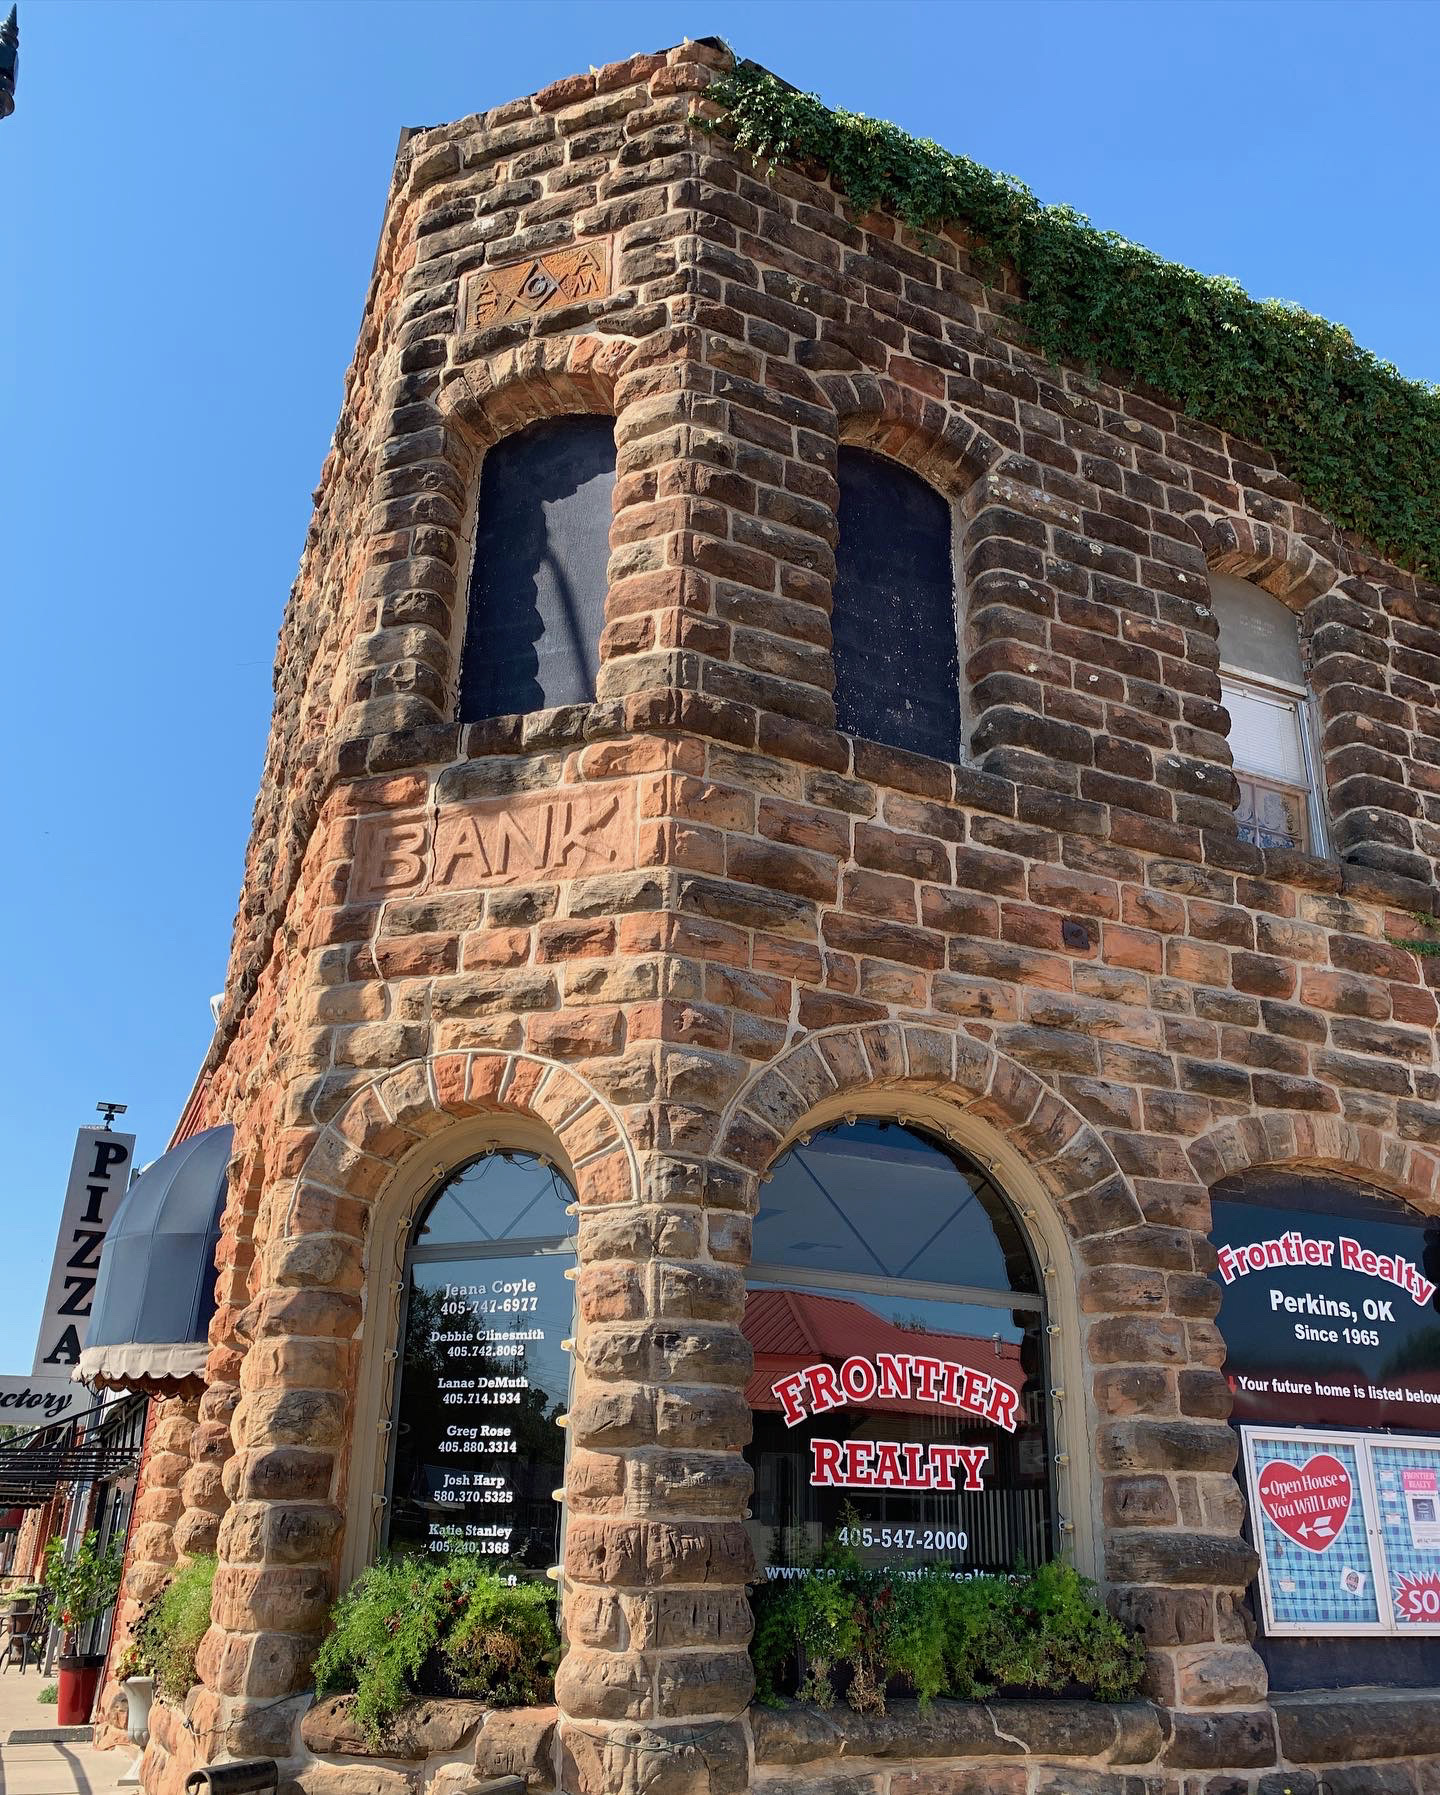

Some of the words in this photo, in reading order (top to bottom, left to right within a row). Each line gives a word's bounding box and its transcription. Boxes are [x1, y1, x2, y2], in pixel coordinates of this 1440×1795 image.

[373, 795, 619, 889] BANK
[43, 1141, 129, 1365] PIZZA
[1217, 1230, 1335, 1285] Frontier
[1338, 1235, 1437, 1307] Realty
[444, 1282, 487, 1300] Jeana
[491, 1279, 536, 1294] Coyle
[440, 1297, 539, 1316] 405-747-6977
[1269, 1289, 1358, 1324] Perkins,
[1362, 1298, 1396, 1322] OK
[430, 1329, 473, 1343] Debbie
[476, 1328, 545, 1341] Clinesmith
[1294, 1323, 1339, 1343] Since
[1342, 1328, 1380, 1346] 1965
[447, 1344, 525, 1358] 405.742.8062
[437, 1377, 475, 1389] Lanae
[478, 1376, 529, 1389] DeMuth
[771, 1353, 1020, 1433] FRONTIER
[1238, 1375, 1269, 1392] Your
[1271, 1378, 1312, 1395] future
[1314, 1382, 1351, 1398] home
[1353, 1384, 1366, 1399] is
[1368, 1385, 1403, 1401] listed
[0, 1388, 72, 1418] ctory
[442, 1392, 521, 1405] 405.714.1934
[446, 1425, 478, 1440] Greg
[480, 1426, 512, 1437] Rose
[438, 1440, 517, 1453] 405.880.3314
[809, 1438, 989, 1491] REALTY
[443, 1474, 471, 1487] Josh
[473, 1474, 505, 1489] Harp
[1270, 1480, 1303, 1499] Open
[1301, 1474, 1338, 1491] House
[1269, 1502, 1295, 1519] You
[1293, 1495, 1320, 1515] Will
[1320, 1495, 1348, 1511] Love
[428, 1523, 463, 1536] Katie
[465, 1524, 513, 1540] Stanley
[838, 1526, 968, 1550] 405-547-2000
[1408, 1590, 1440, 1614] SO
